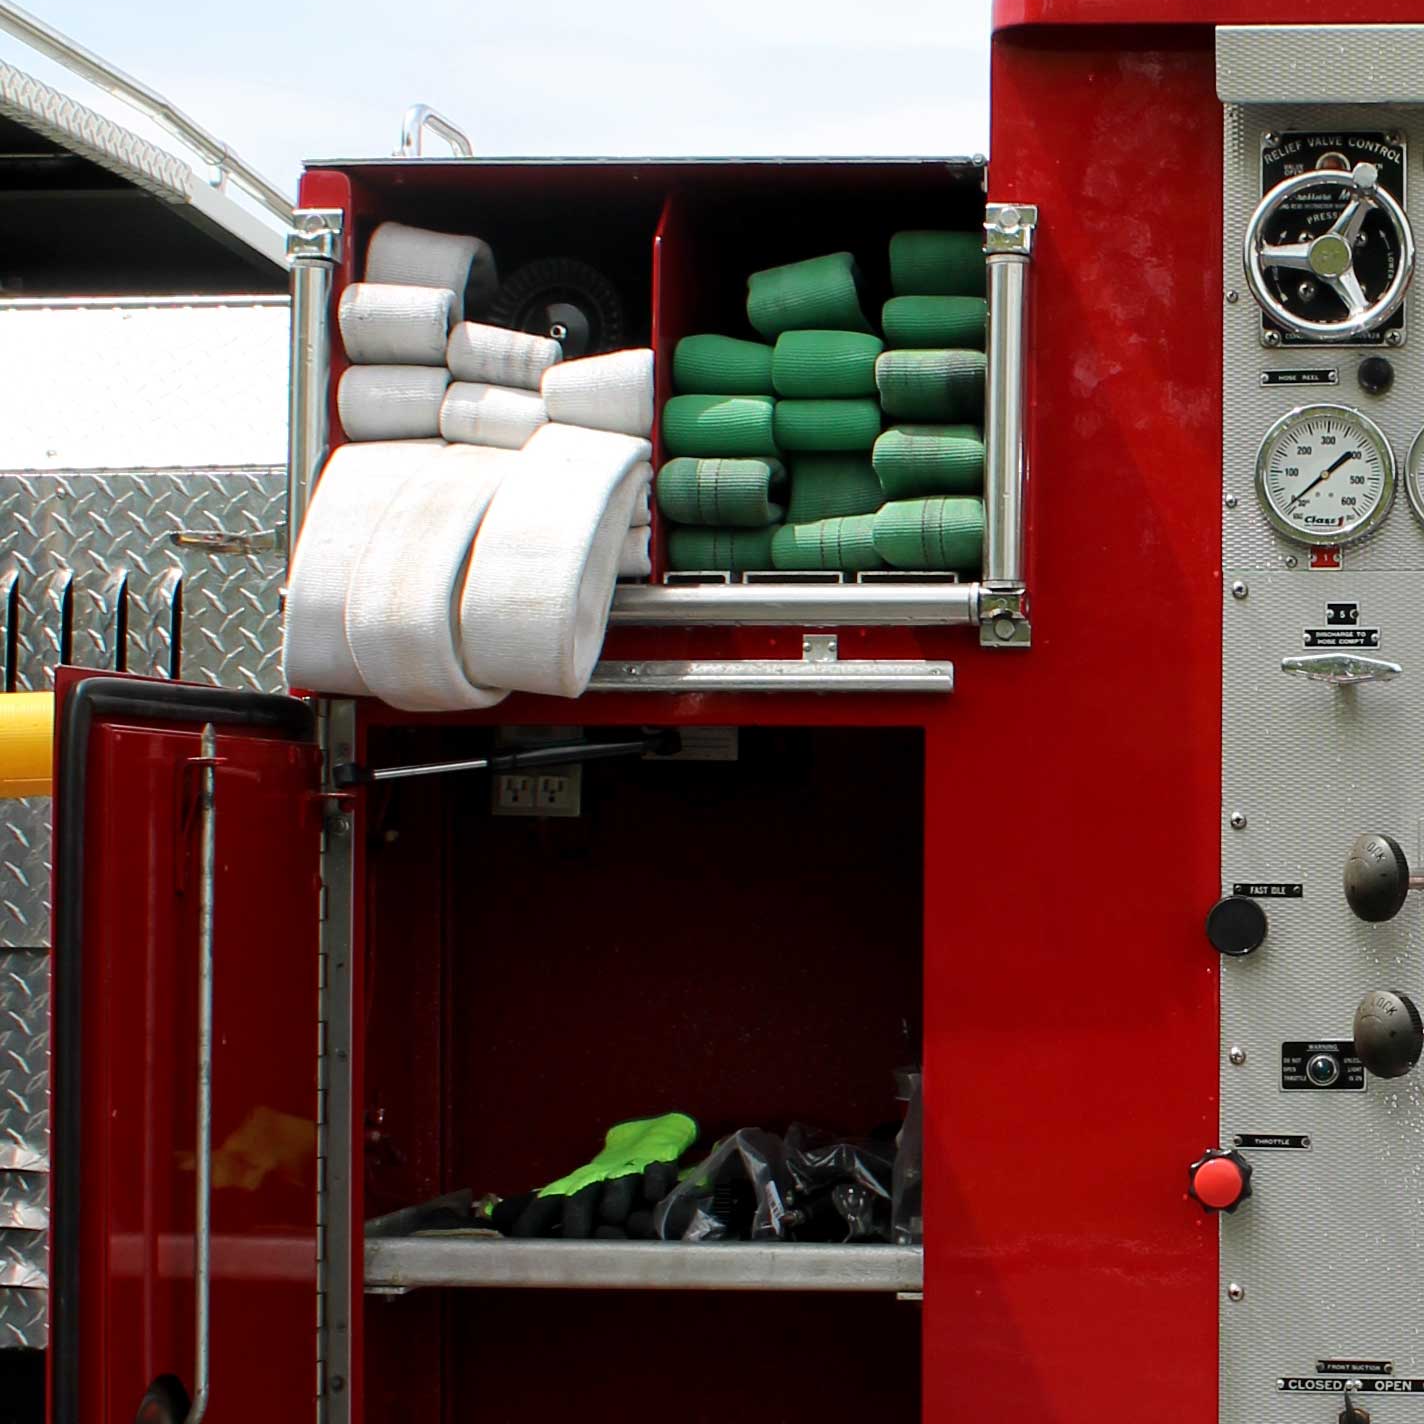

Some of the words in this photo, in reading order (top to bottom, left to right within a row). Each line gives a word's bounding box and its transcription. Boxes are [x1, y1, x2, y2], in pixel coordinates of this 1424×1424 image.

[1263, 140, 1301, 165] RELIEF
[1306, 136, 1344, 148] VALVE
[1348, 138, 1401, 164] CONTROL
[1320, 436, 1336, 445] 300
[1296, 446, 1312, 456] 200
[1285, 468, 1299, 477] 100
[1350, 476, 1365, 485] 500
[1341, 496, 1357, 506] 600
[1250, 886, 1268, 895] FAST
[1272, 887, 1286, 895] IDLE
[1288, 1379, 1342, 1390] CLOSED
[1374, 1380, 1412, 1391] OPEN
